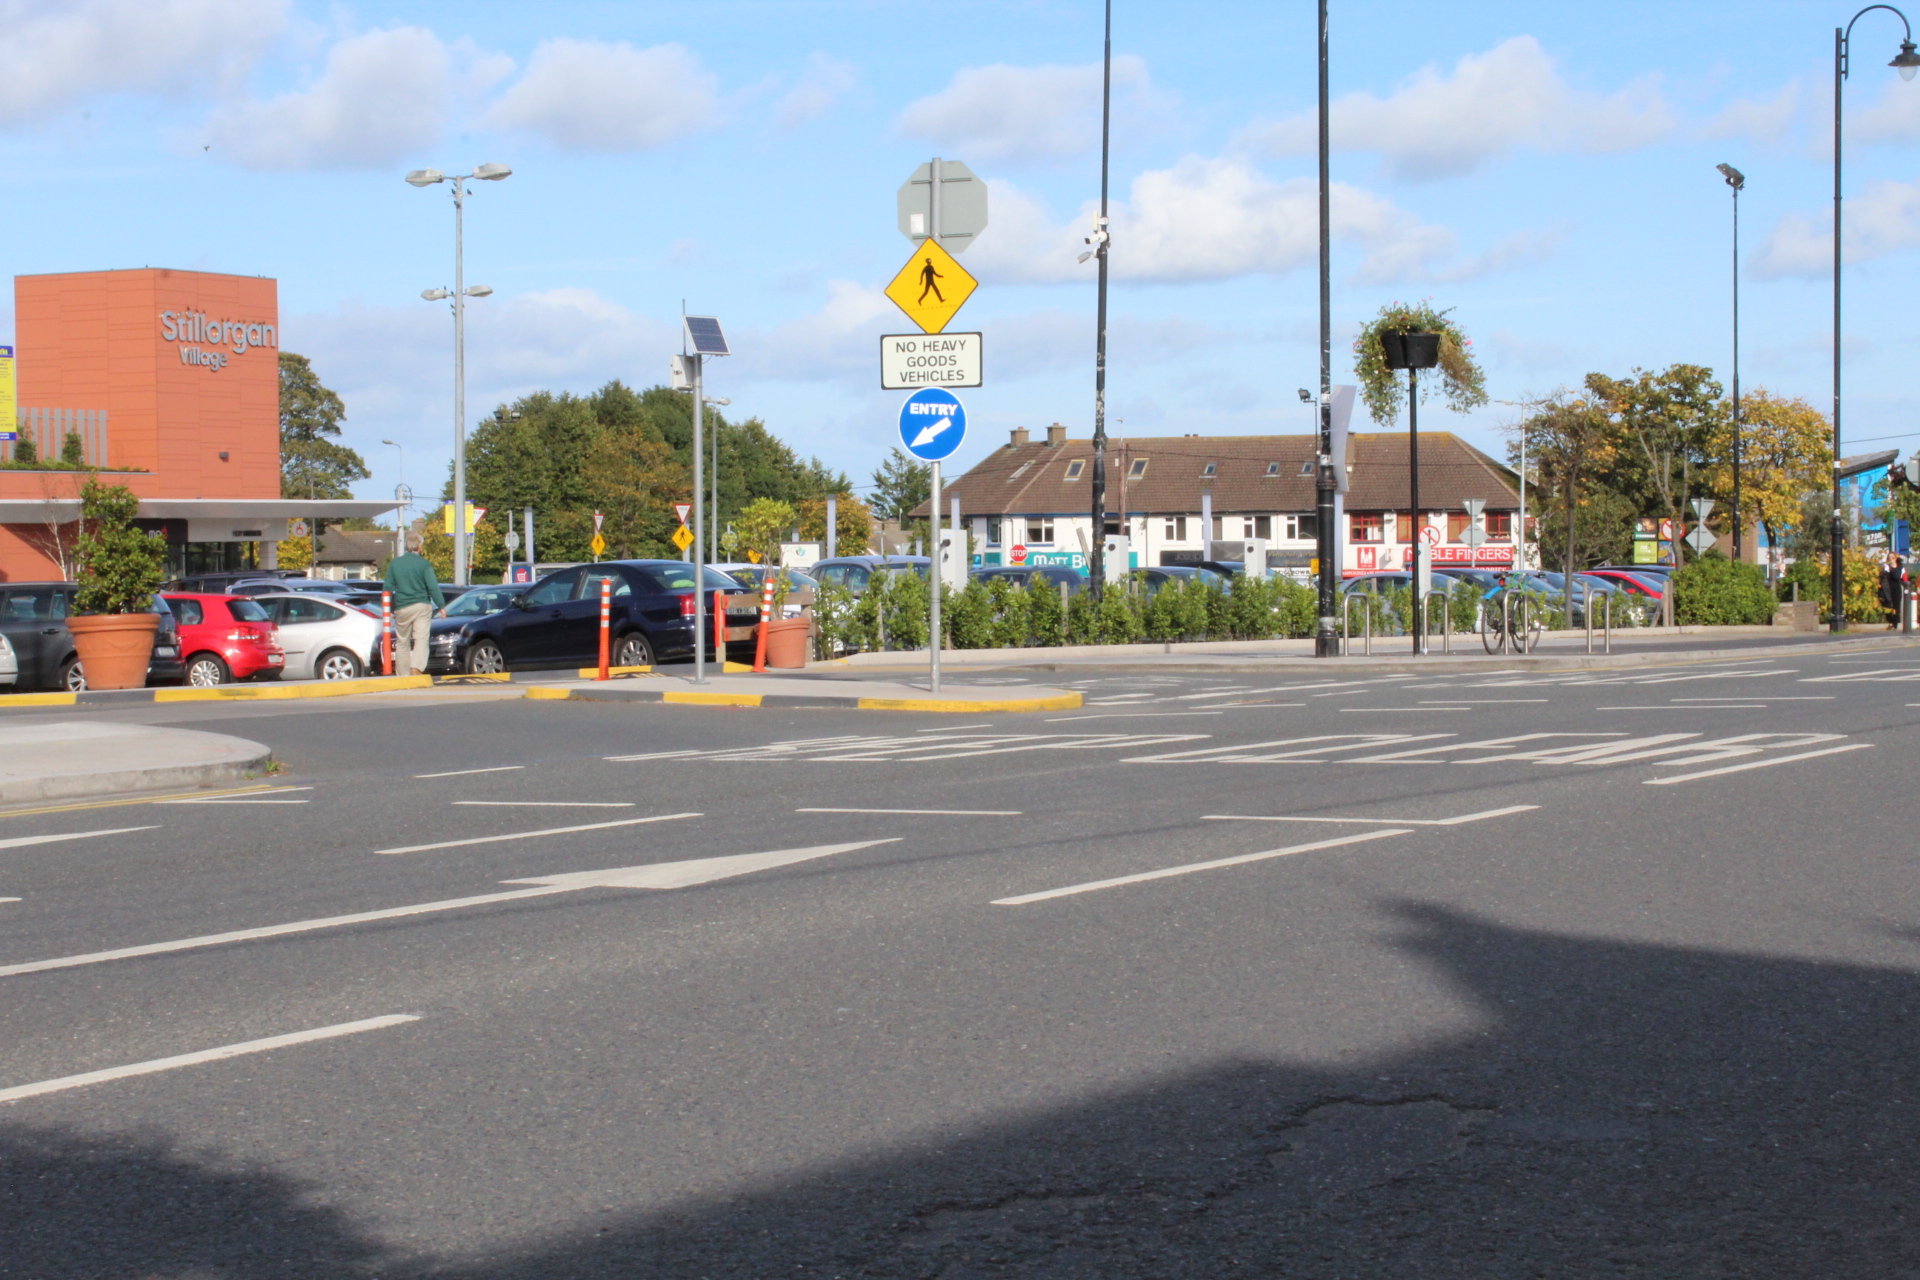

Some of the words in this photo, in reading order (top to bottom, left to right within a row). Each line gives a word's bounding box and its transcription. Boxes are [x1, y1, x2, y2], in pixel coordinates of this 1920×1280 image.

[162, 310, 277, 354] Stillorgan
[896, 341, 917, 353] NO
[923, 339, 967, 352] HEAVY
[179, 345, 228, 372] Village
[906, 355, 957, 368] GOODS
[900, 369, 965, 383] VEHICLES
[909, 402, 958, 416] ENTRY
[1010, 549, 1027, 558] STOP
[1407, 549, 1454, 560] NBLE
[1456, 548, 1511, 560] FINGERS
